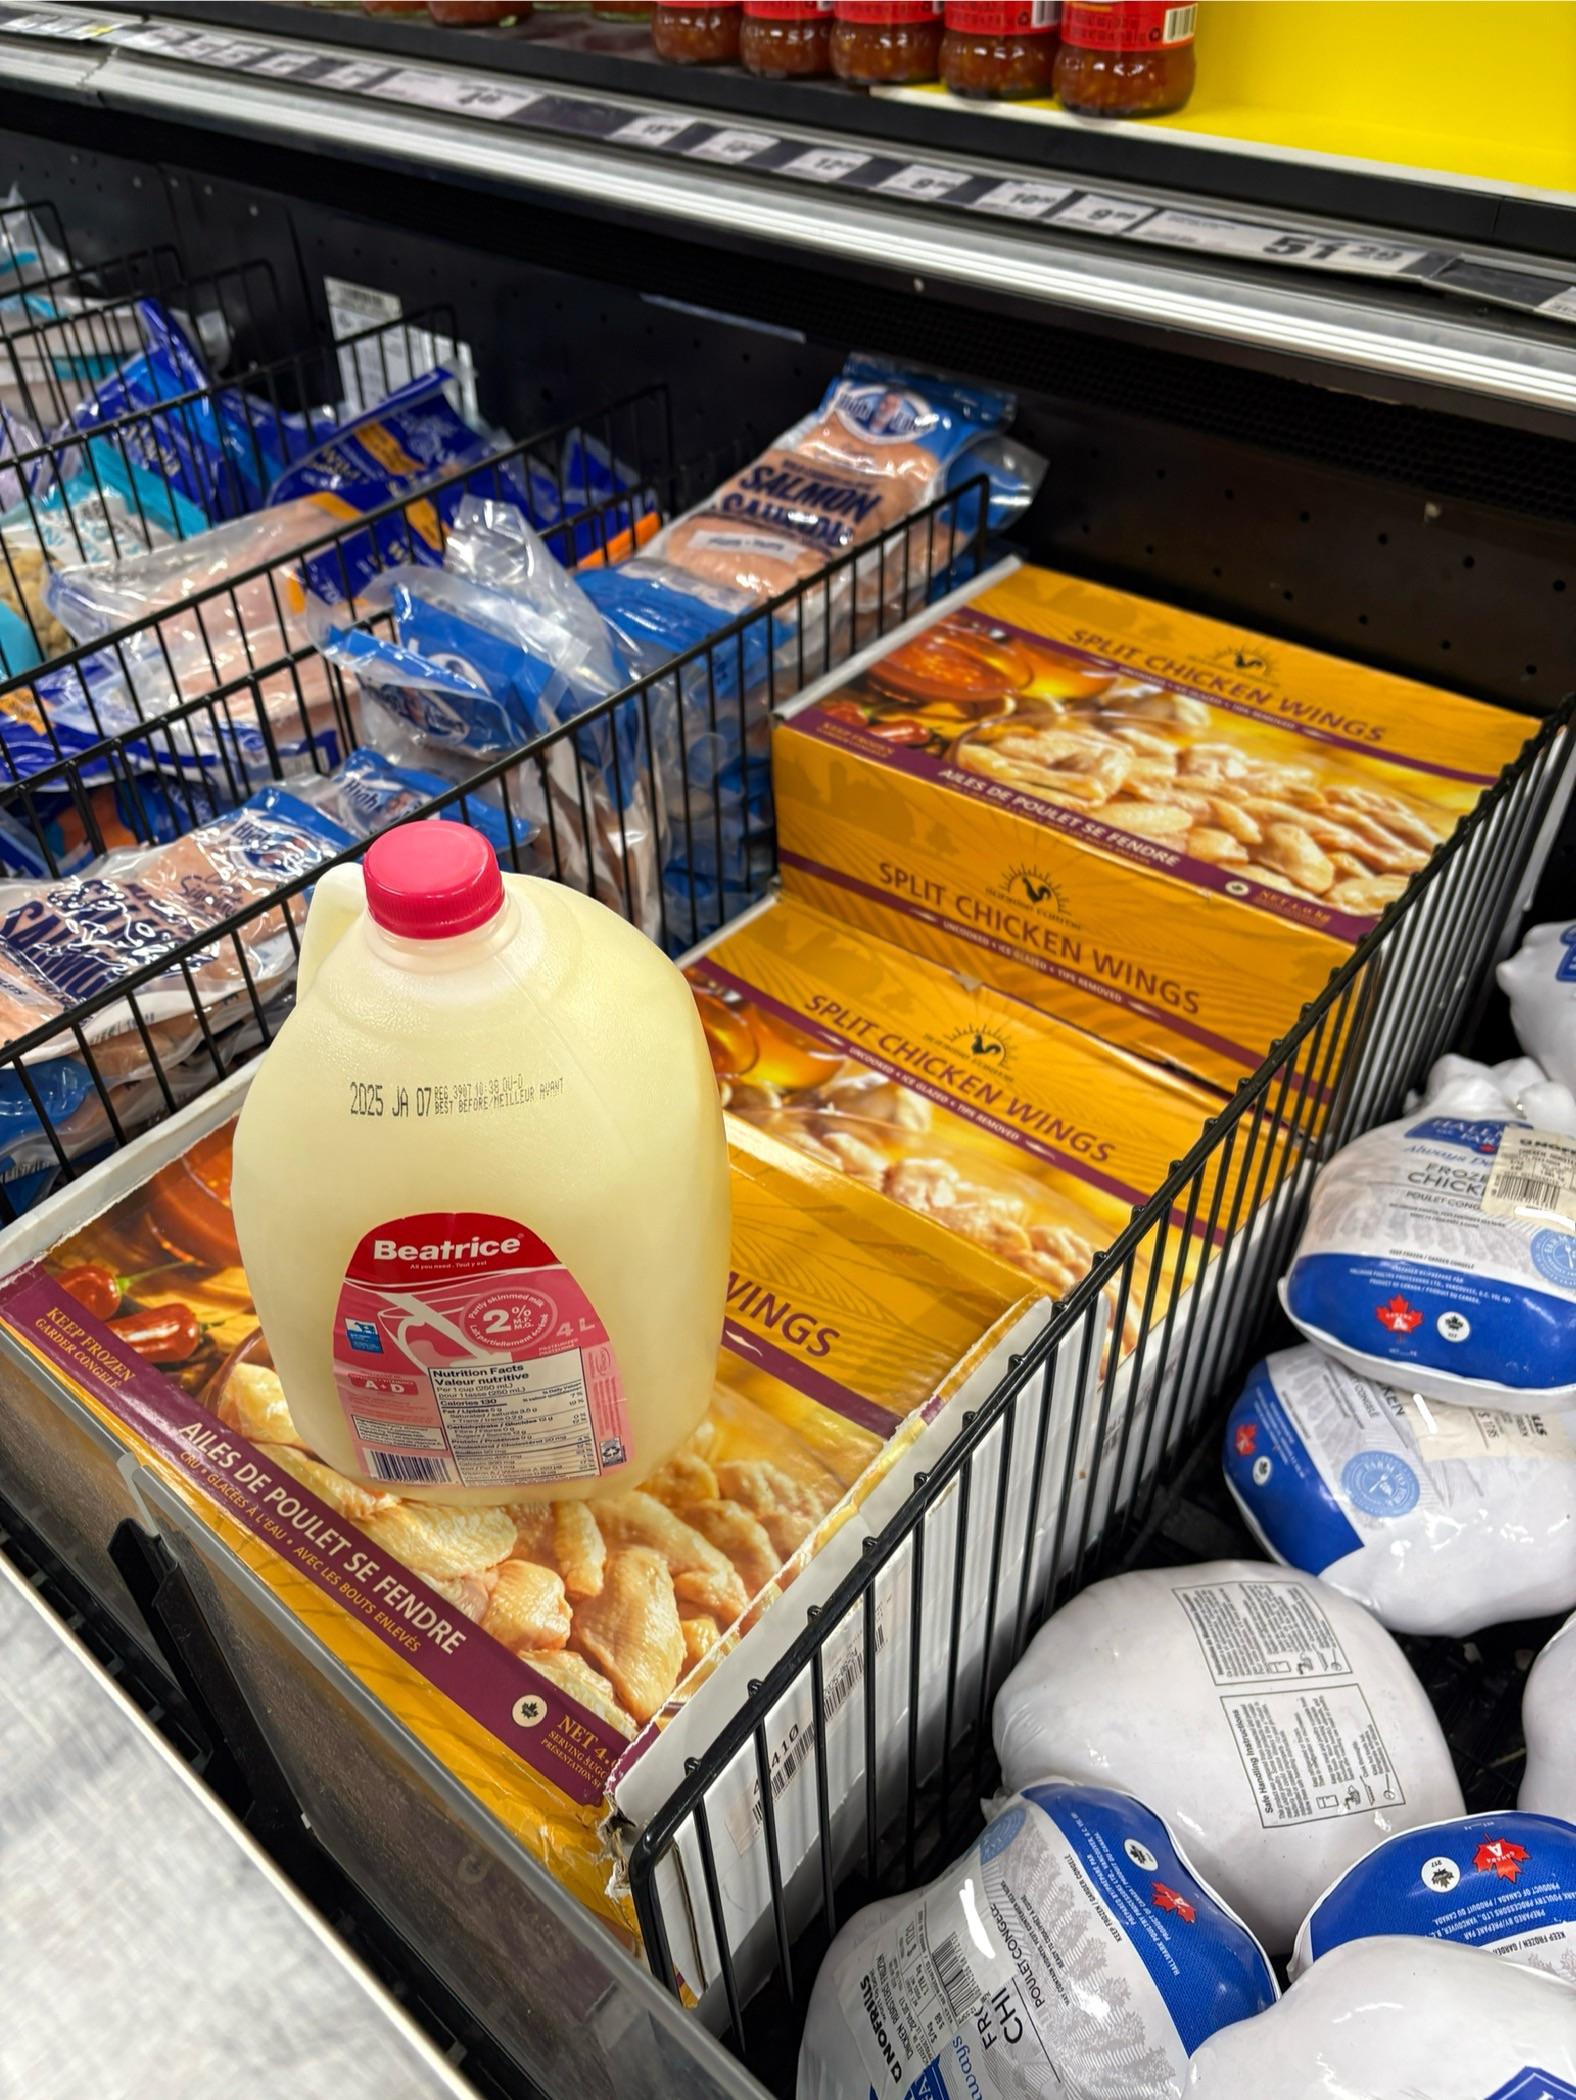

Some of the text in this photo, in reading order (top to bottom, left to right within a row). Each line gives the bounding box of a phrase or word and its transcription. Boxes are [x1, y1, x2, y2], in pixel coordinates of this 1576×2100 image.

[740, 466, 882, 525] SALMON
[1068, 629, 1142, 658] SPLIT
[1145, 654, 1275, 706] CHICKEN
[1278, 698, 1387, 742] WINGS
[938, 769, 1181, 868] AILES DE POULET SE FENDRE
[879, 862, 945, 905] SPLIT
[955, 894, 1083, 964] CHICKEN
[1091, 948, 1201, 1016] WINGS
[943, 920, 990, 946] UNCOOKED
[1077, 976, 1123, 1004] REMOVED
[805, 995, 879, 1038] SPLIT
[878, 1032, 1003, 1105] CHICKEN
[1005, 1096, 1117, 1162] WINGS
[350, 1082, 432, 1117] 2025 JA 07
[848, 1046, 895, 1076] UNCOOKED
[900, 1075, 915, 1088] ICE
[916, 1082, 949, 1105] GLAZED
[955, 1104, 976, 1119] TIPS
[975, 1113, 1020, 1142] REMOVED
[434, 1100, 454, 1115] BEST
[1408, 1172, 1487, 1197] CHICK
[1426, 1163, 1489, 1184] FROZE
[373, 1236, 521, 1261] Beatrice
[469, 1303, 487, 1319] Partly
[487, 1294, 529, 1304] skimmed
[556, 1317, 595, 1337] 4 L
[35, 1318, 123, 1389] GARDER CONGELÉ
[46, 1307, 136, 1382] KEEP FROZEN
[433, 1365, 524, 1377] Nutrition Facts
[480, 1373, 529, 1384] nutritive
[179, 1422, 467, 1656] AILES DE POULET SE FENDRE
[179, 1451, 421, 1652] CRU GLACÉES À L'EAU AVEC LES BOUTS ENLEVÉS
[558, 1714, 598, 1748] NET
[548, 1731, 584, 1761] SERVING
[1232, 1710, 1274, 1814] Safe Handling Instructions
[1086, 1835, 1110, 1871] VANCOUVER,
[1086, 1853, 1098, 1867] PAR
[1108, 1852, 1116, 1863] DU
[1486, 1842, 1504, 1858] A
[1111, 1863, 1128, 1885] PRODUIT
[1064, 1854, 1122, 1943] KEEP FROZEN GARDER CONGELÉ
[1116, 1880, 1142, 1916] PROCESSORS
[1130, 1889, 1146, 1907] CANADA
[1498, 1891, 1522, 1903] CANADA
[1522, 1888, 1531, 1898] OF
[1530, 1881, 1561, 1896] PRODUCT
[1534, 1892, 1563, 1906] POULTRY
[1116, 1899, 1136, 1925] PREPARED
[1142, 1906, 1152, 1915] OF
[1456, 1908, 1466, 1917] DU
[1465, 1899, 1494, 1914] PRODUIT
[1493, 1899, 1535, 1917] PROCESSORS
[1513, 1908, 1546, 1924] PREPARED
[1139, 1917, 1160, 1942] POULTRY
[1149, 1915, 1171, 1941] PRODUCT
[1442, 1917, 1478, 1934] VANCOUVER,
[1463, 1930, 1476, 1940] PAR
[1549, 1932, 1566, 1941] KEEP
[1522, 1935, 1548, 1950] FROZEN
[1157, 1942, 1180, 1975] HALLMARK
[1017, 1960, 1045, 2008] POULET
[860, 1976, 895, 2063] NOFRILLS
[896, 2023, 916, 2060] CHICKEN
